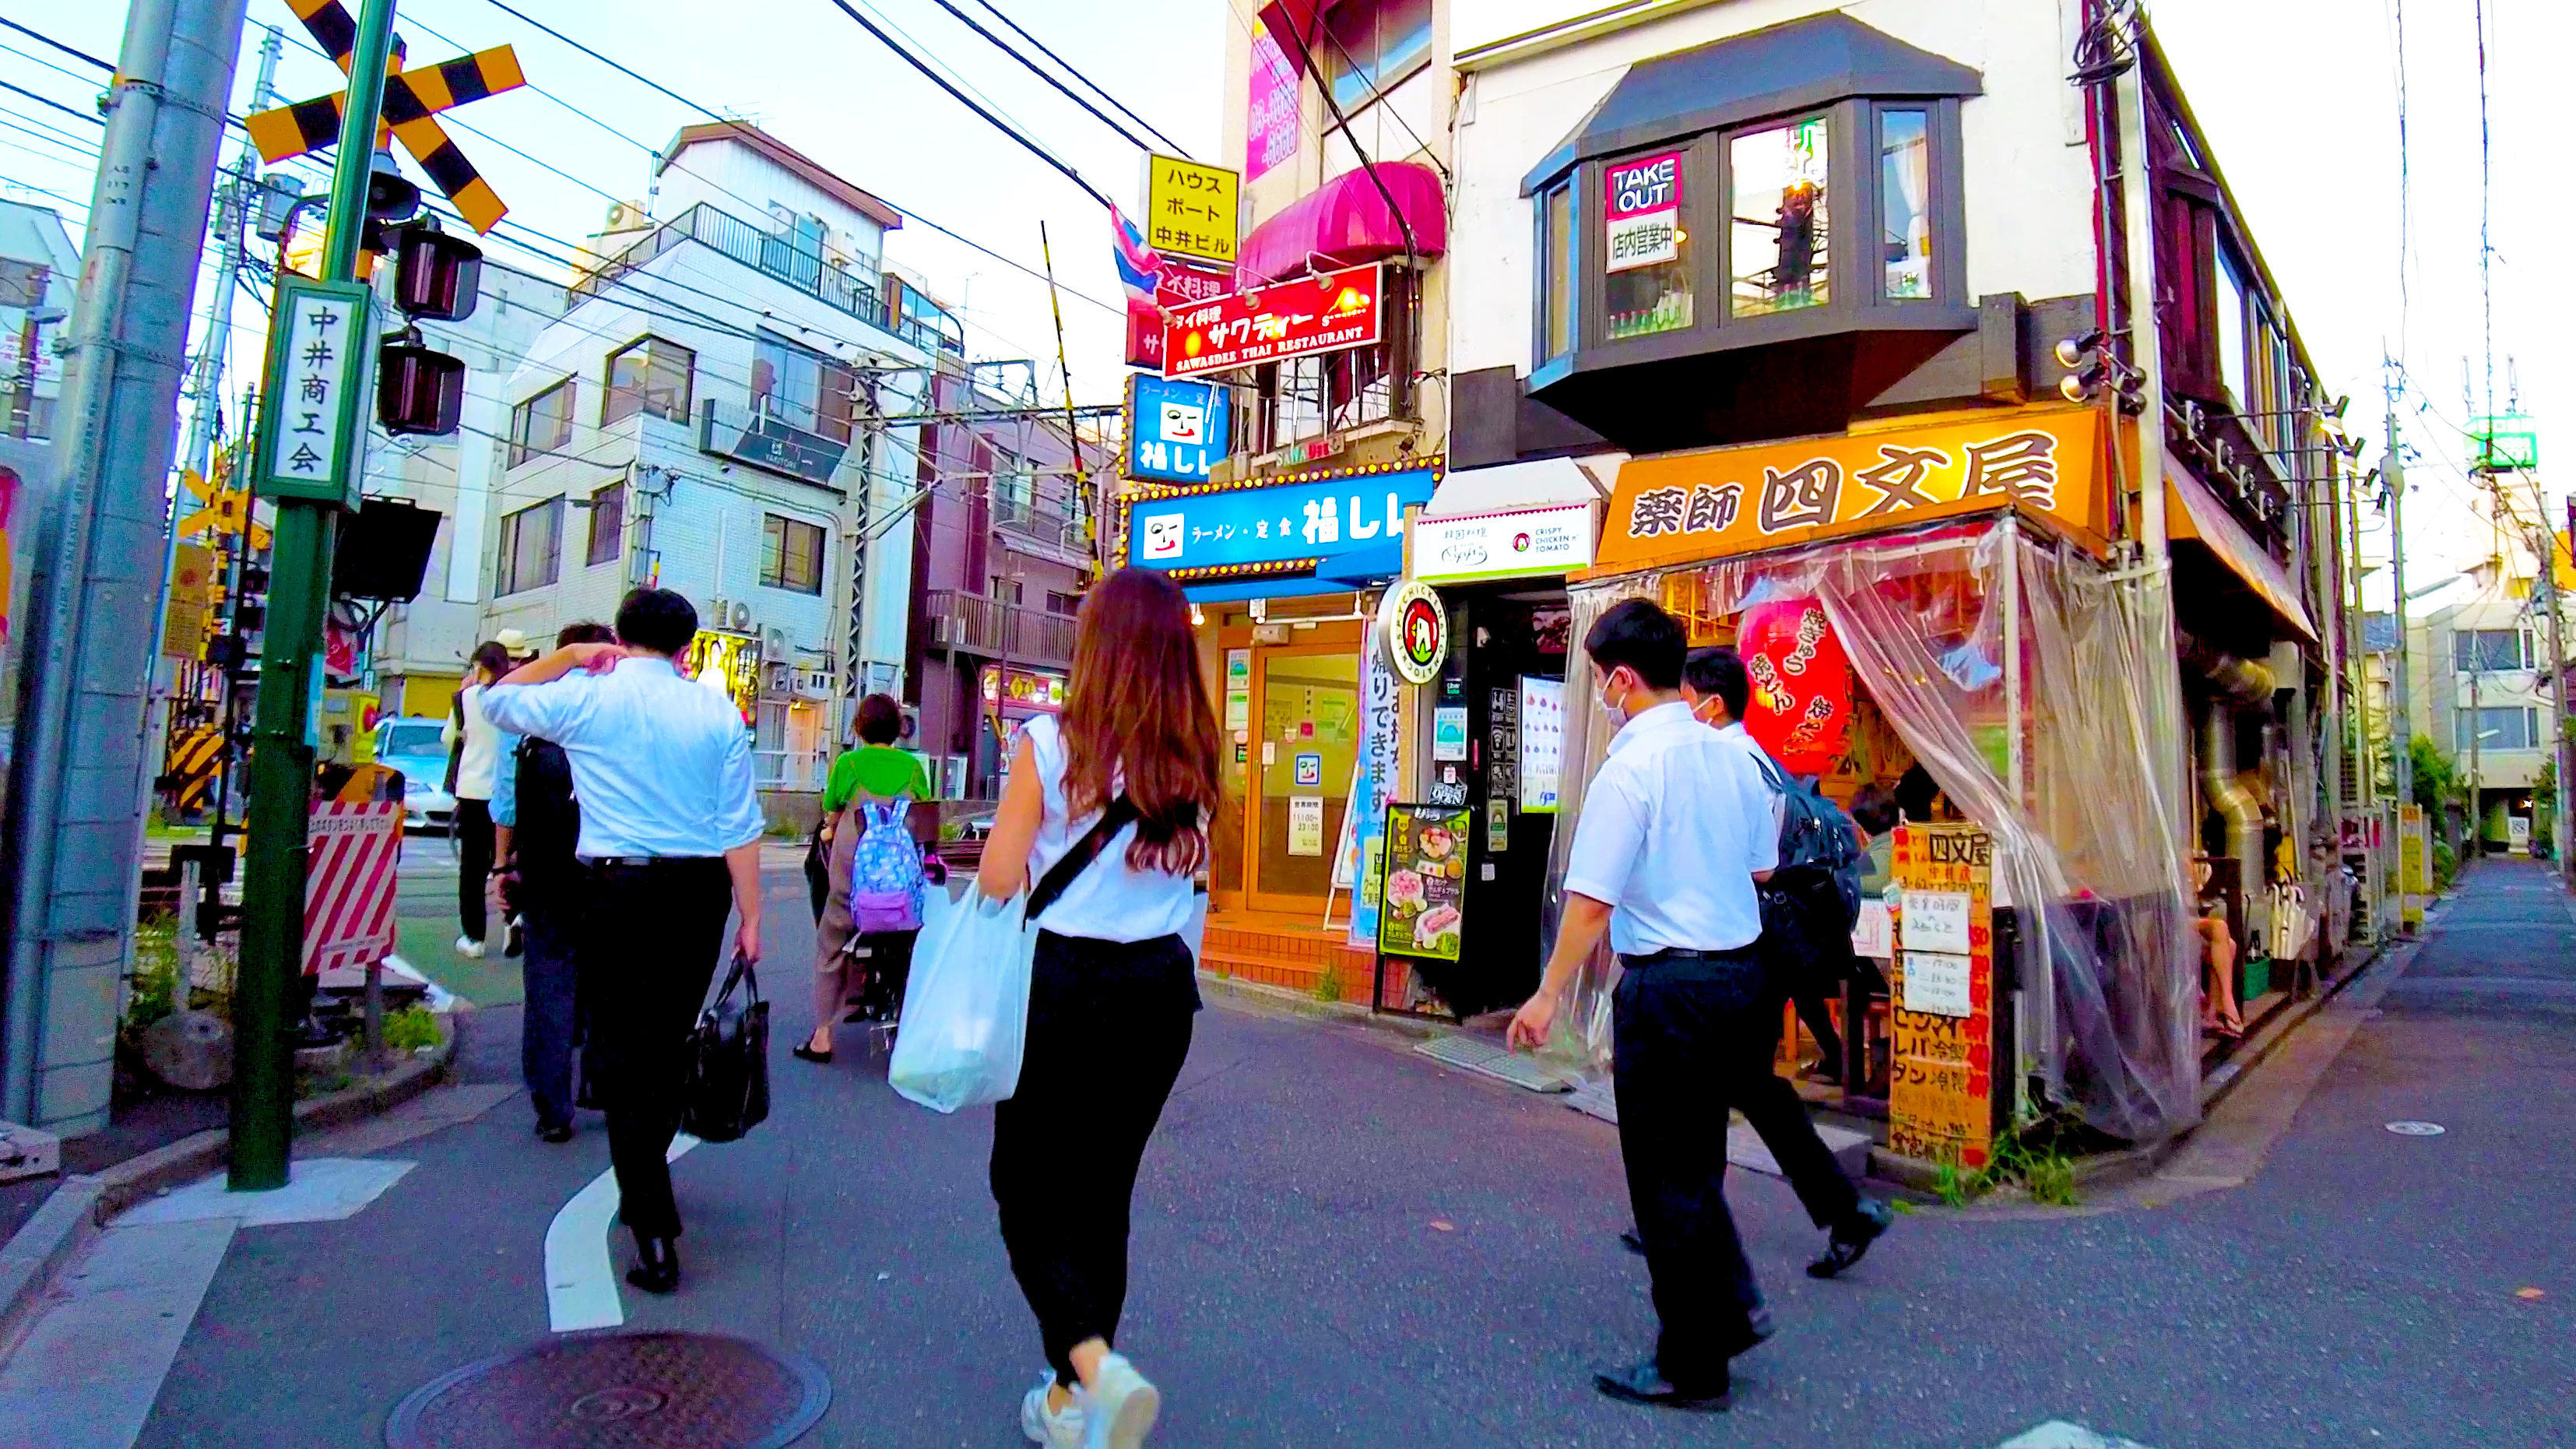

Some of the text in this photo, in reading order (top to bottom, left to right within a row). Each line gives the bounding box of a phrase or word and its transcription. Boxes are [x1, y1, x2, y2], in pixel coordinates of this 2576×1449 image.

[1168, 169, 1221, 194] ハウス
[1613, 158, 1675, 191] TAKE
[1618, 182, 1668, 212] OUT
[1156, 226, 1229, 254] 中井ビル
[1612, 222, 1672, 260] 店内営業中
[1208, 312, 1313, 349] サワディー
[1176, 325, 1363, 371] SAWASDEE THAI RESTAURANT
[288, 306, 339, 473] 中井商工会
[1629, 429, 2058, 538] 薬師 四文屋
[1535, 527, 1562, 536] CRISPY
[1535, 536, 1569, 544] CHICKEN
[1535, 544, 1569, 553] TOMATO
[1929, 832, 1990, 866] 四文屋
